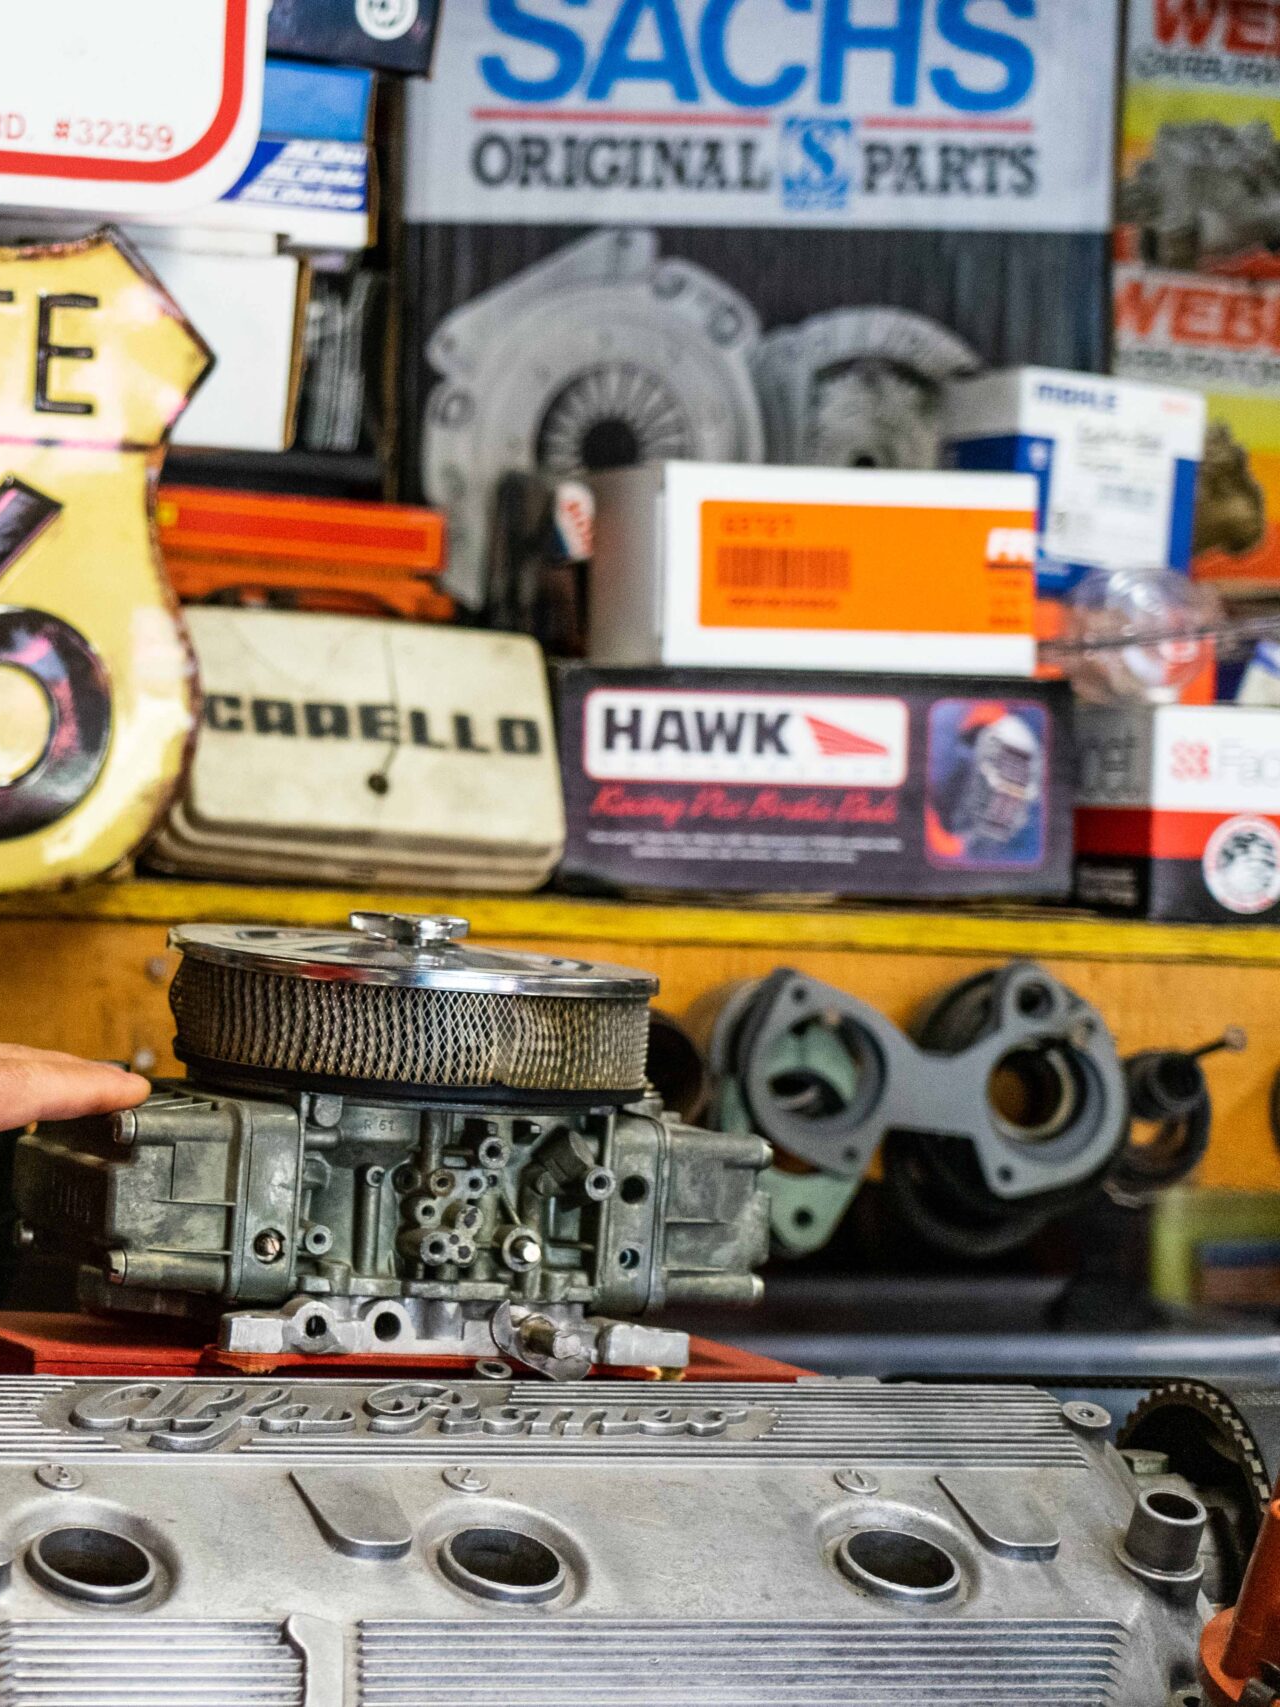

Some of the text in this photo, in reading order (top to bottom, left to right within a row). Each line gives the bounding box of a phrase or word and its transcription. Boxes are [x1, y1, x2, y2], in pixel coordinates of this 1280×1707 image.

[478, 0, 1036, 112] SACHS
[1153, 0, 1280, 56] WE
[55, 117, 175, 153] #32359
[471, 133, 771, 193] ORIGINAL
[861, 142, 1037, 199] PARTS
[204, 693, 542, 757] CARELLO
[604, 707, 791, 756] HAWK
[363, 1383, 747, 1437] Romeo
